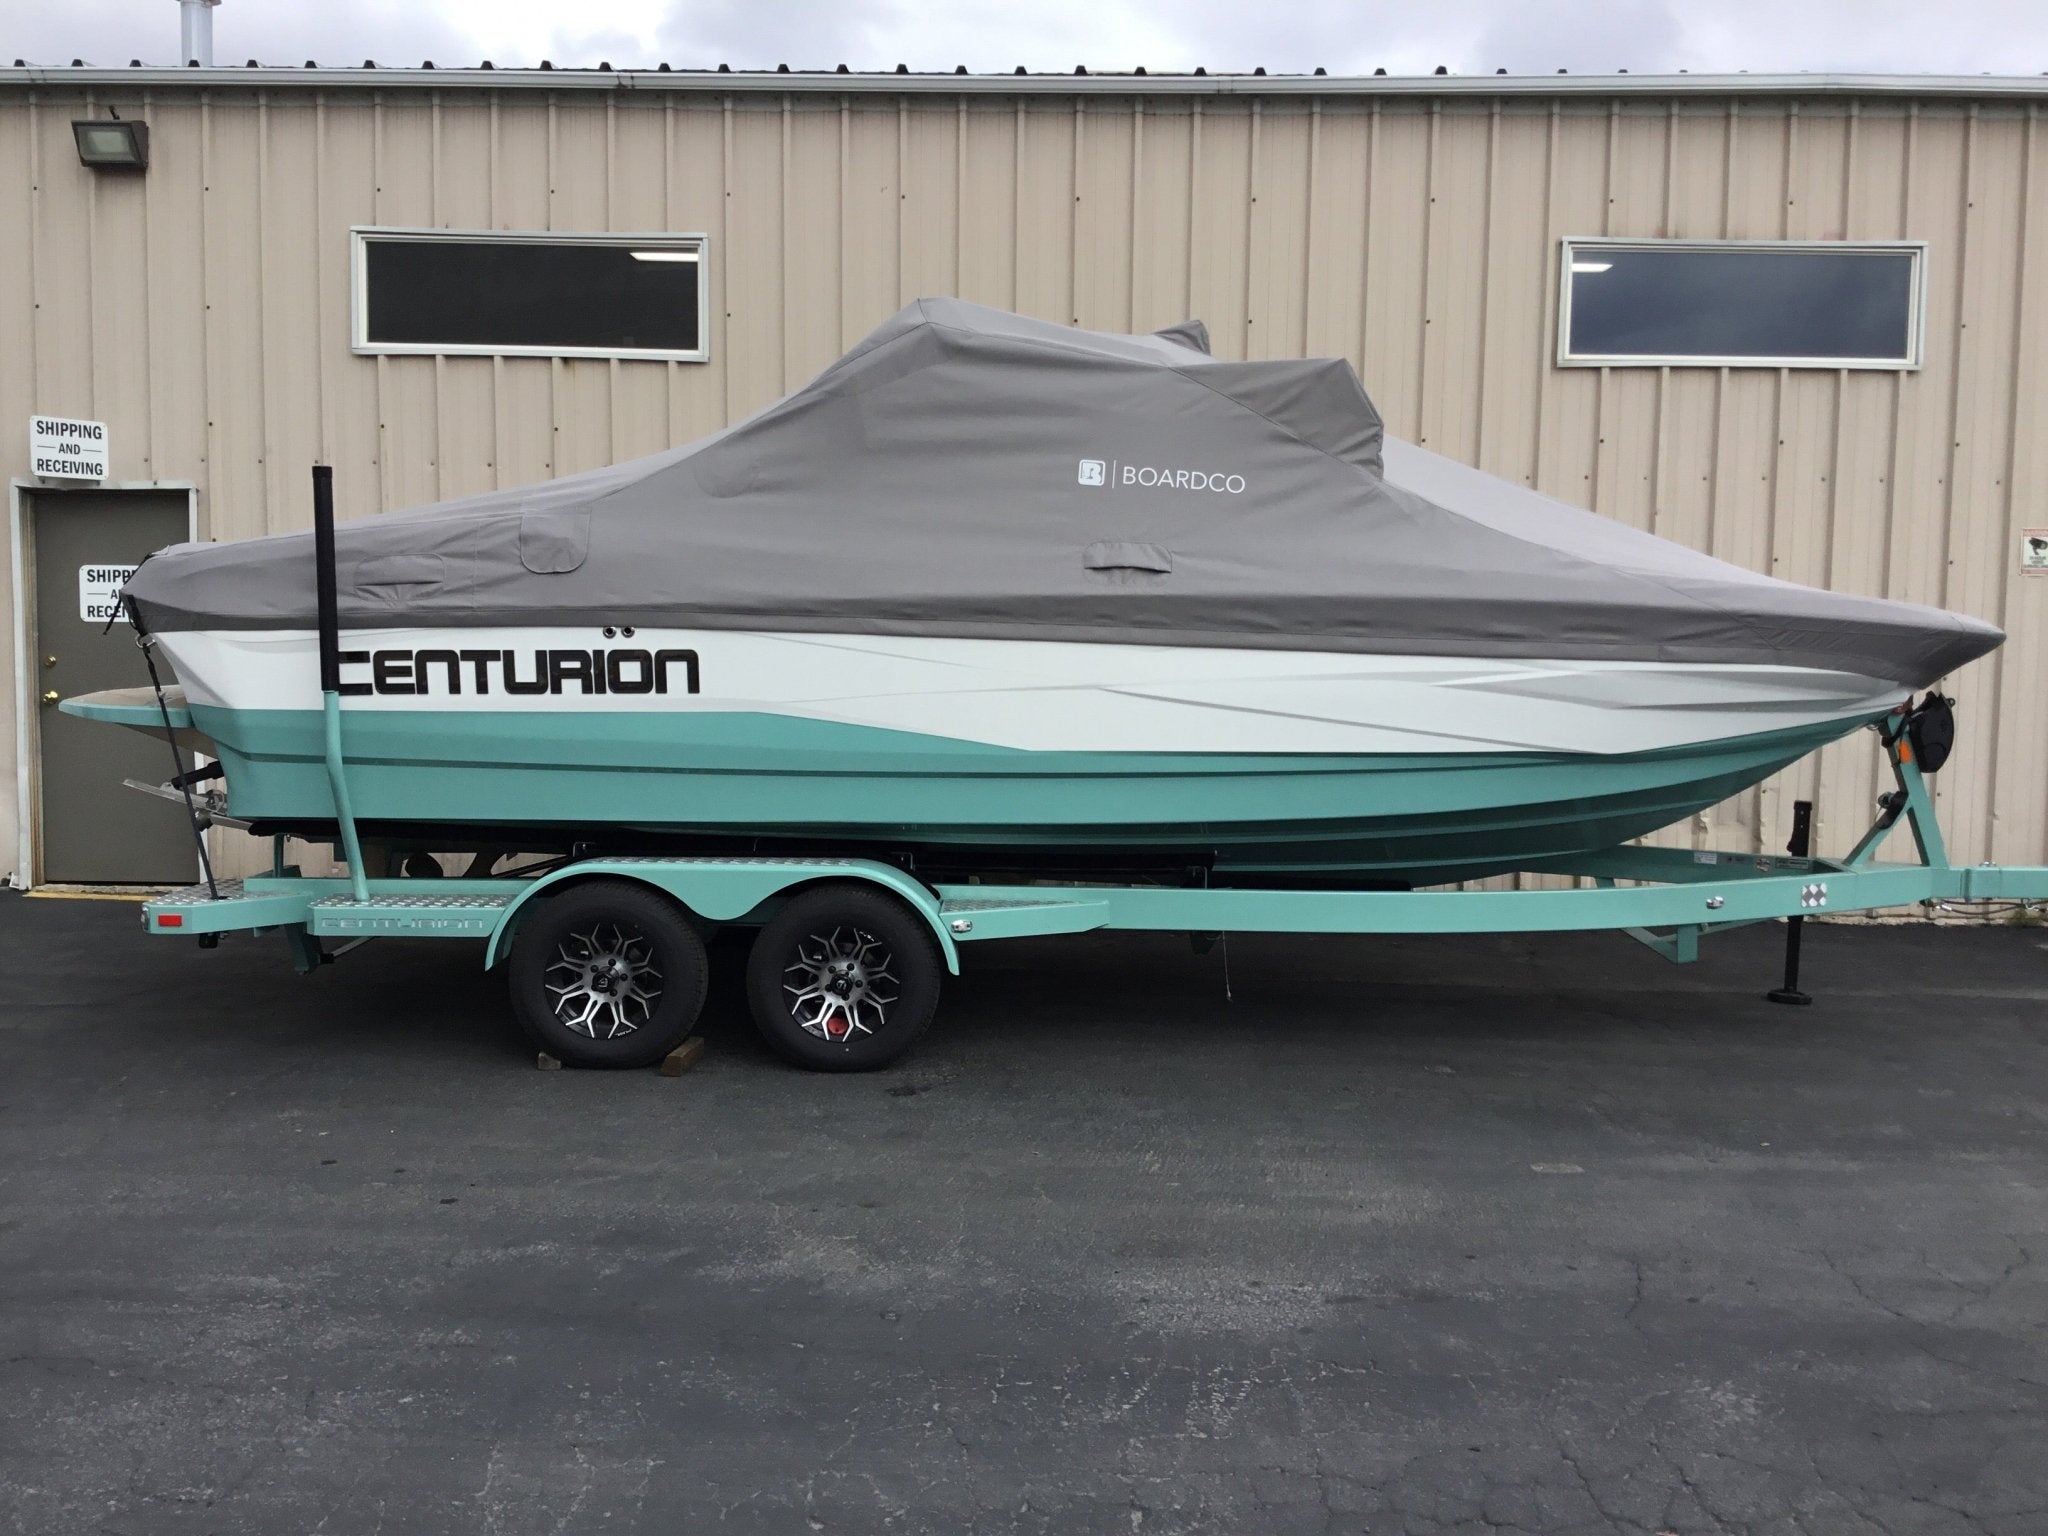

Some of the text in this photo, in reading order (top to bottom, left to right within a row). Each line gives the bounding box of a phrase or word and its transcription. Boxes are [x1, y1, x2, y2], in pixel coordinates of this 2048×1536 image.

[36, 420, 103, 440] SHIPPING
[58, 443, 81, 455] AND
[36, 458, 103, 475] RECEIVING
[1123, 466, 1246, 494] BOARDCO
[337, 649, 700, 696] CENTURION
[321, 918, 483, 929] CENTURION
